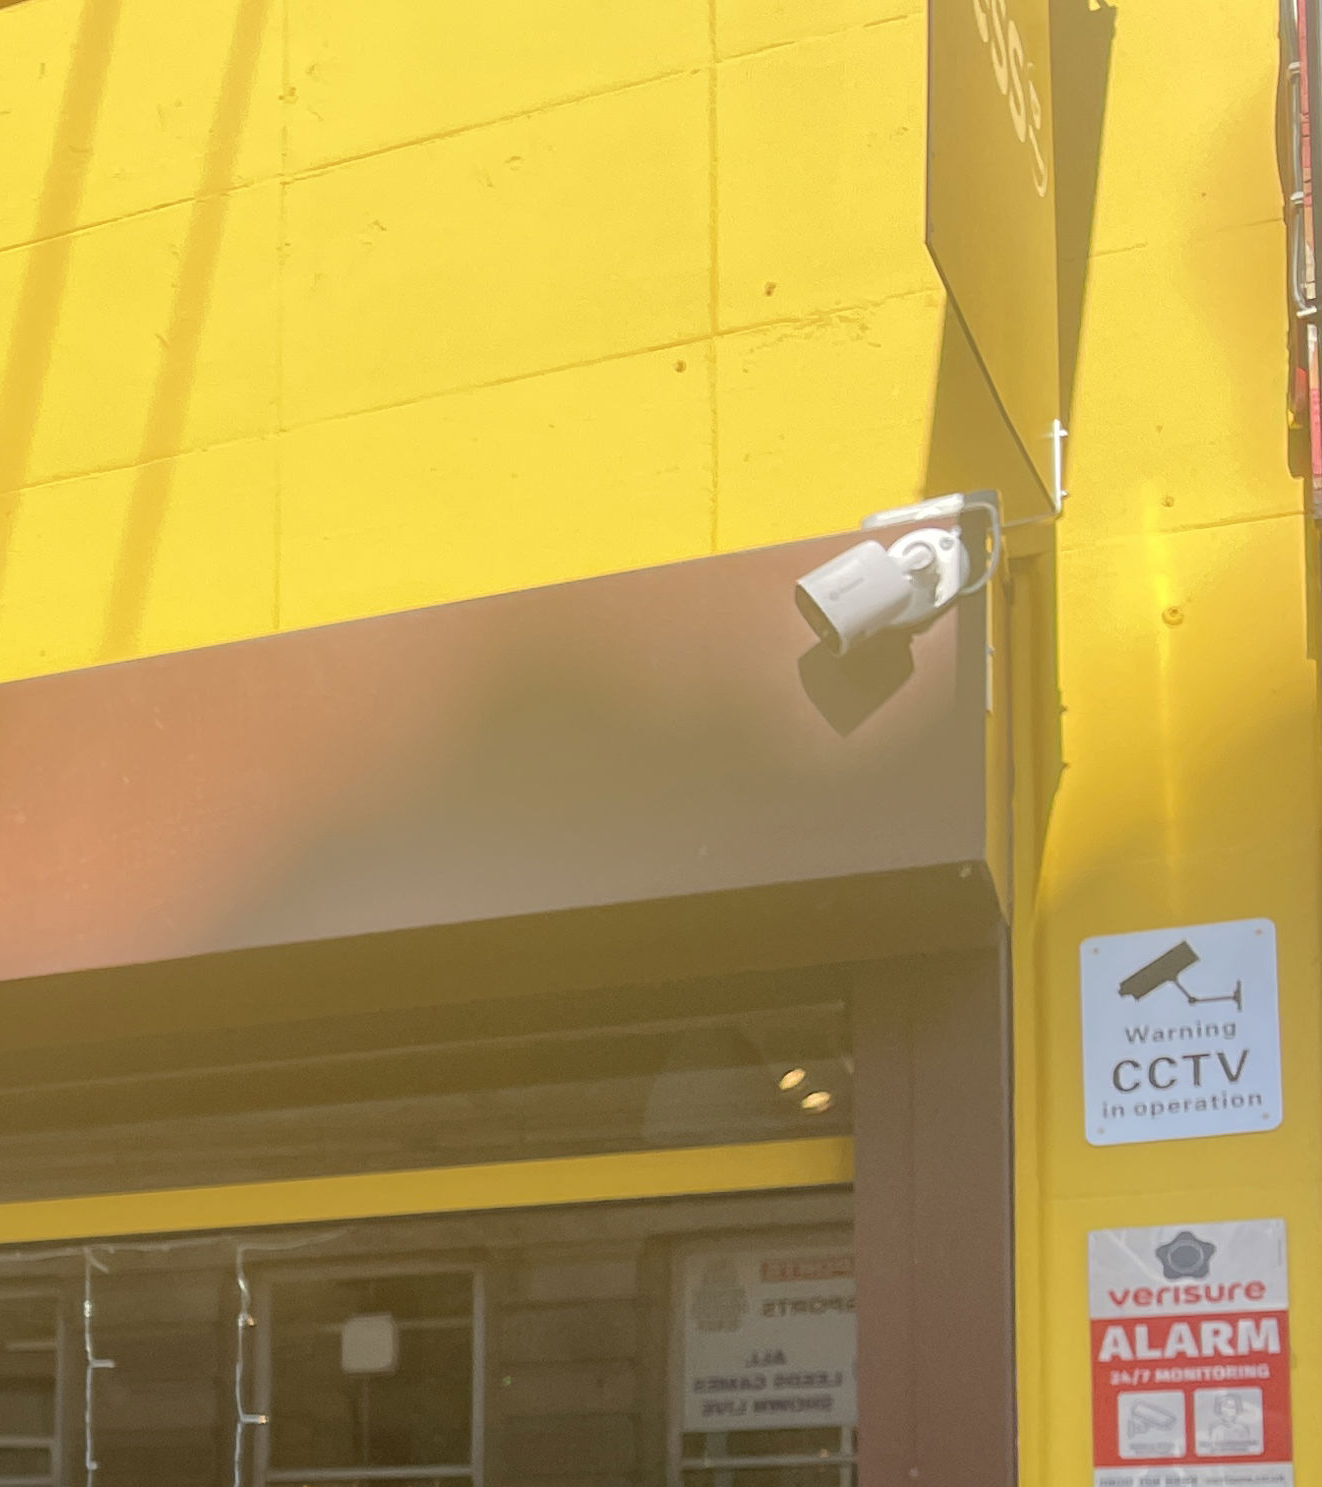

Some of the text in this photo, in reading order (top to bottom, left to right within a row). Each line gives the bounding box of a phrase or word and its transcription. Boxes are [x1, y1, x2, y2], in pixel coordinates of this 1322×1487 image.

[1125, 1021, 1237, 1043] Warning
[1113, 1049, 1249, 1093] CCTV
[1103, 1092, 1262, 1118] in operation
[1108, 1280, 1266, 1307] verisure
[1098, 1317, 1280, 1362] ALARM
[1111, 1364, 1270, 1385] 24/7 MONITORING
